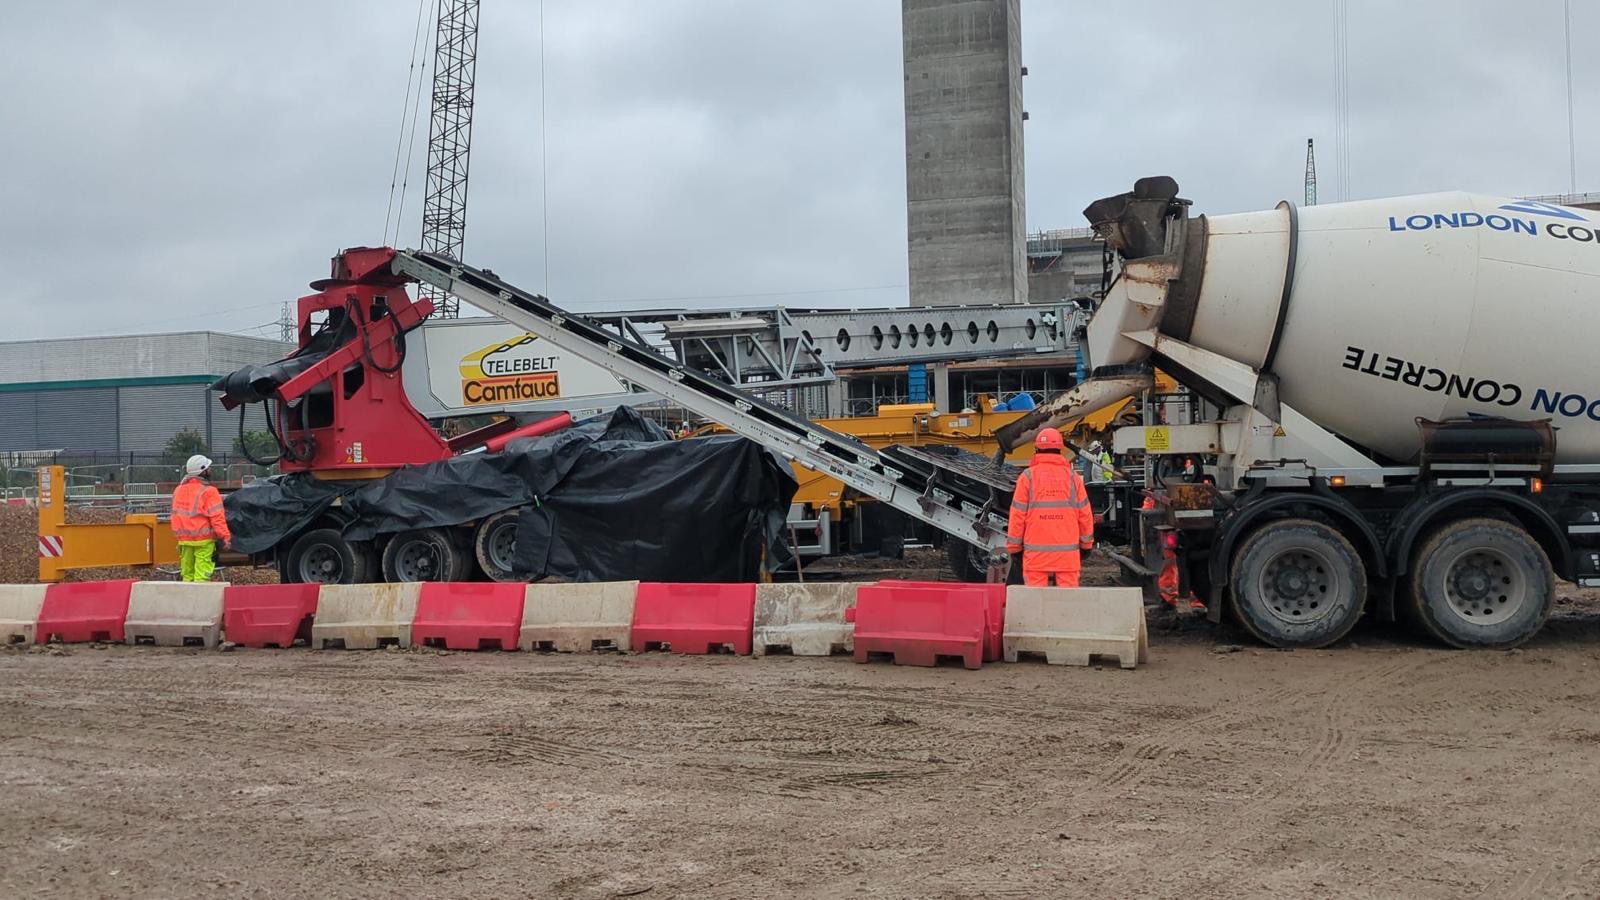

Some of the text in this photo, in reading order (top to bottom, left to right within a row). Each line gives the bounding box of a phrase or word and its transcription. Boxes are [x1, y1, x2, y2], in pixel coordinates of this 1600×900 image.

[1389, 212, 1600, 244] LONDON CO
[487, 356, 556, 374] TELEBELT
[1342, 346, 1522, 406] CONCRETE
[464, 375, 559, 402] Camfaud
